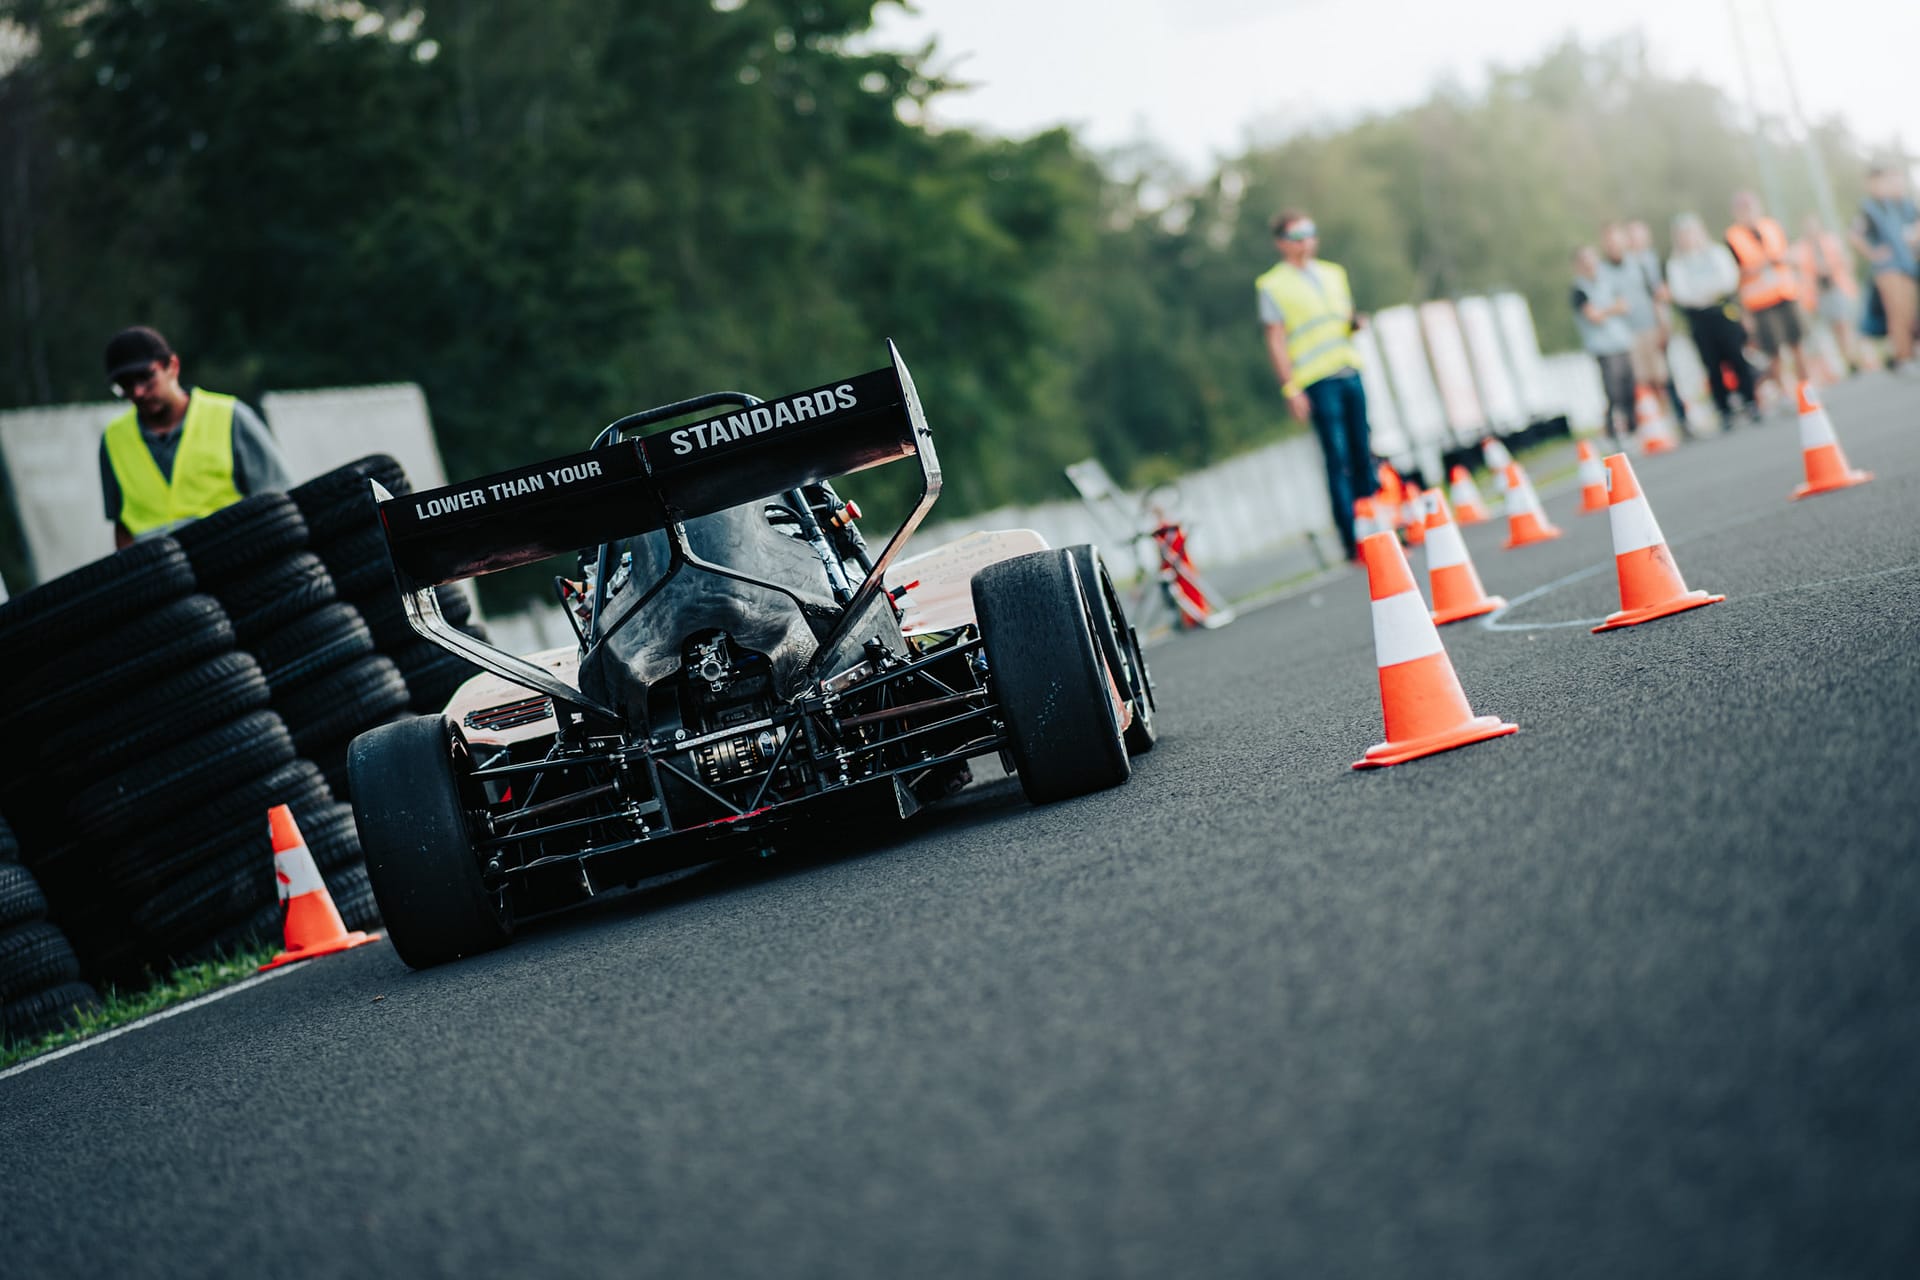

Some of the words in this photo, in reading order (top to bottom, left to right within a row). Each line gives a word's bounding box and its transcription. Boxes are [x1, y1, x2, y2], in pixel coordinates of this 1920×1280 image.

[415, 490, 487, 520] LOWER
[488, 474, 545, 501] THAN
[546, 461, 602, 486] YOUR
[671, 385, 857, 455] STANDARDS
